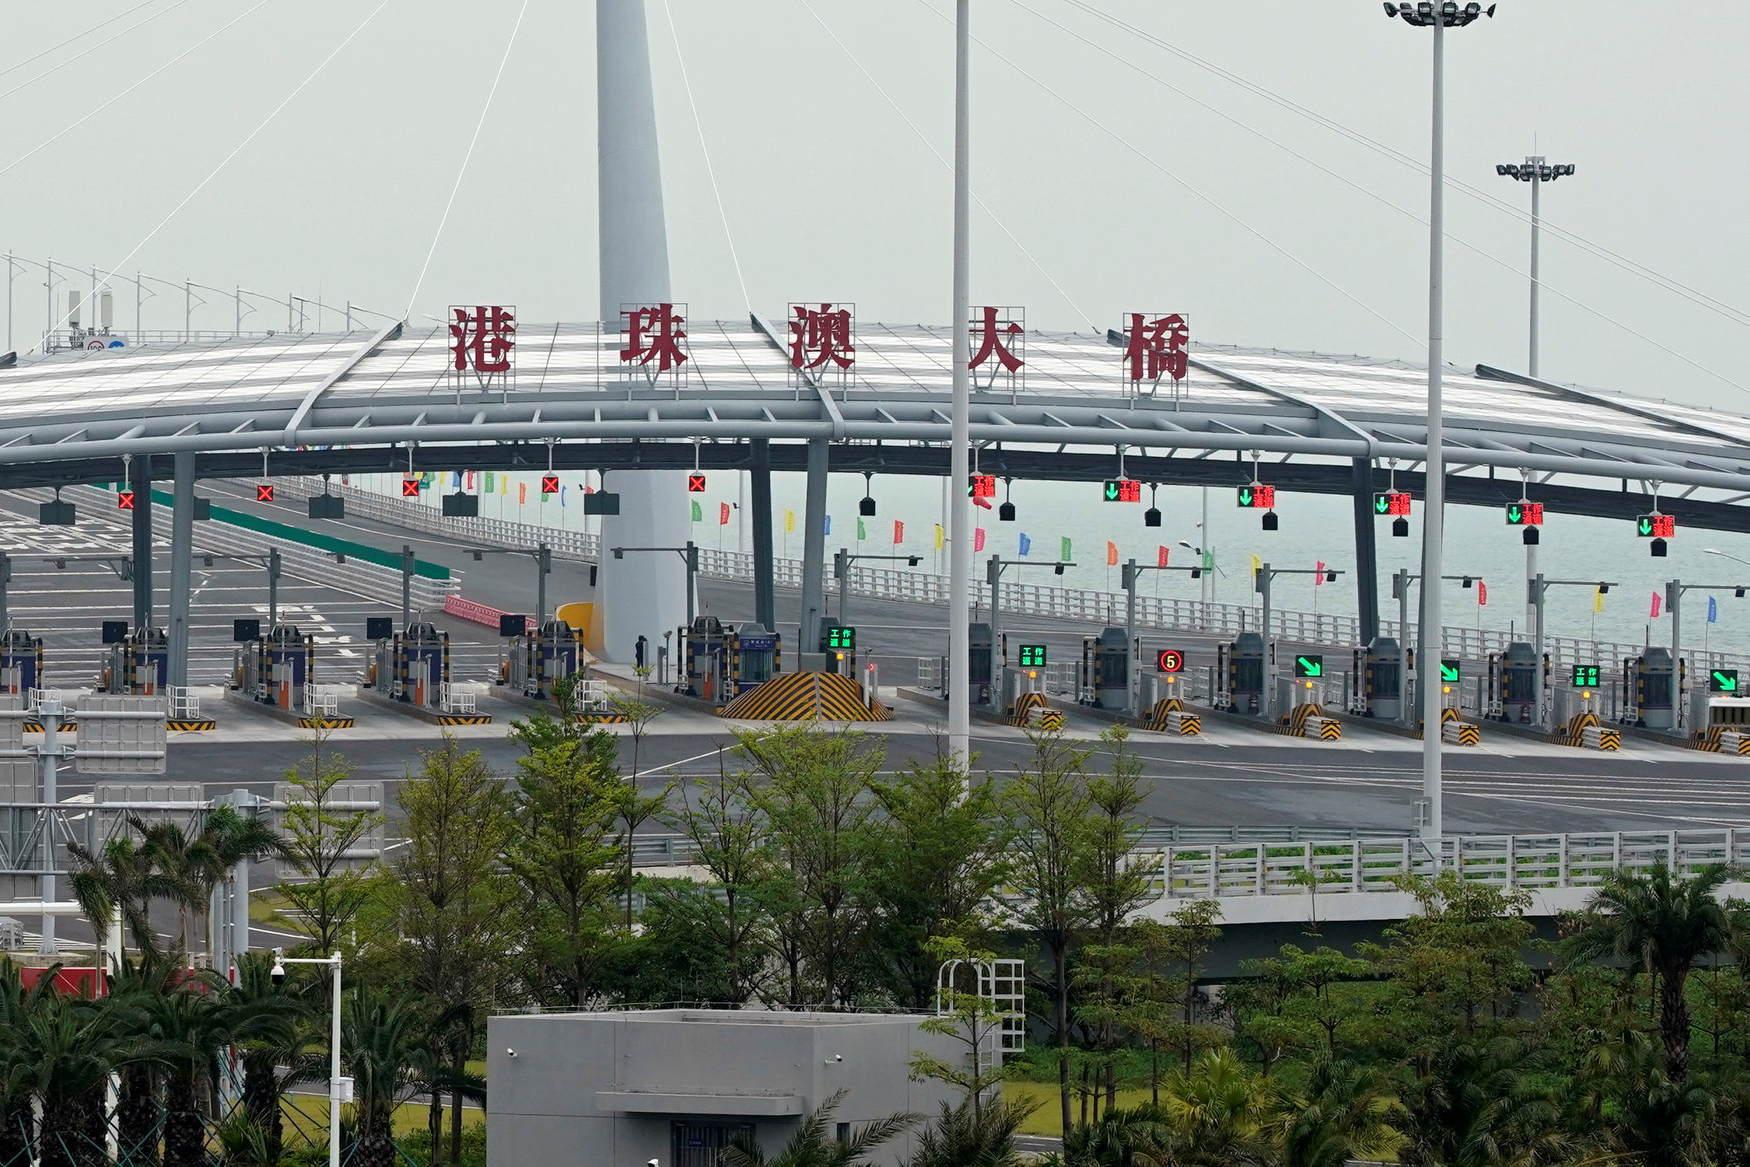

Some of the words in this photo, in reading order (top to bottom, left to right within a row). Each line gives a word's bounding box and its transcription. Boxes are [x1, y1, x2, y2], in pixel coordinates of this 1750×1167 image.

[830, 629, 851, 637] 工作
[1022, 647, 1043, 656] 工作
[1166, 655, 1176, 668] 5
[1576, 667, 1597, 676] 工作
